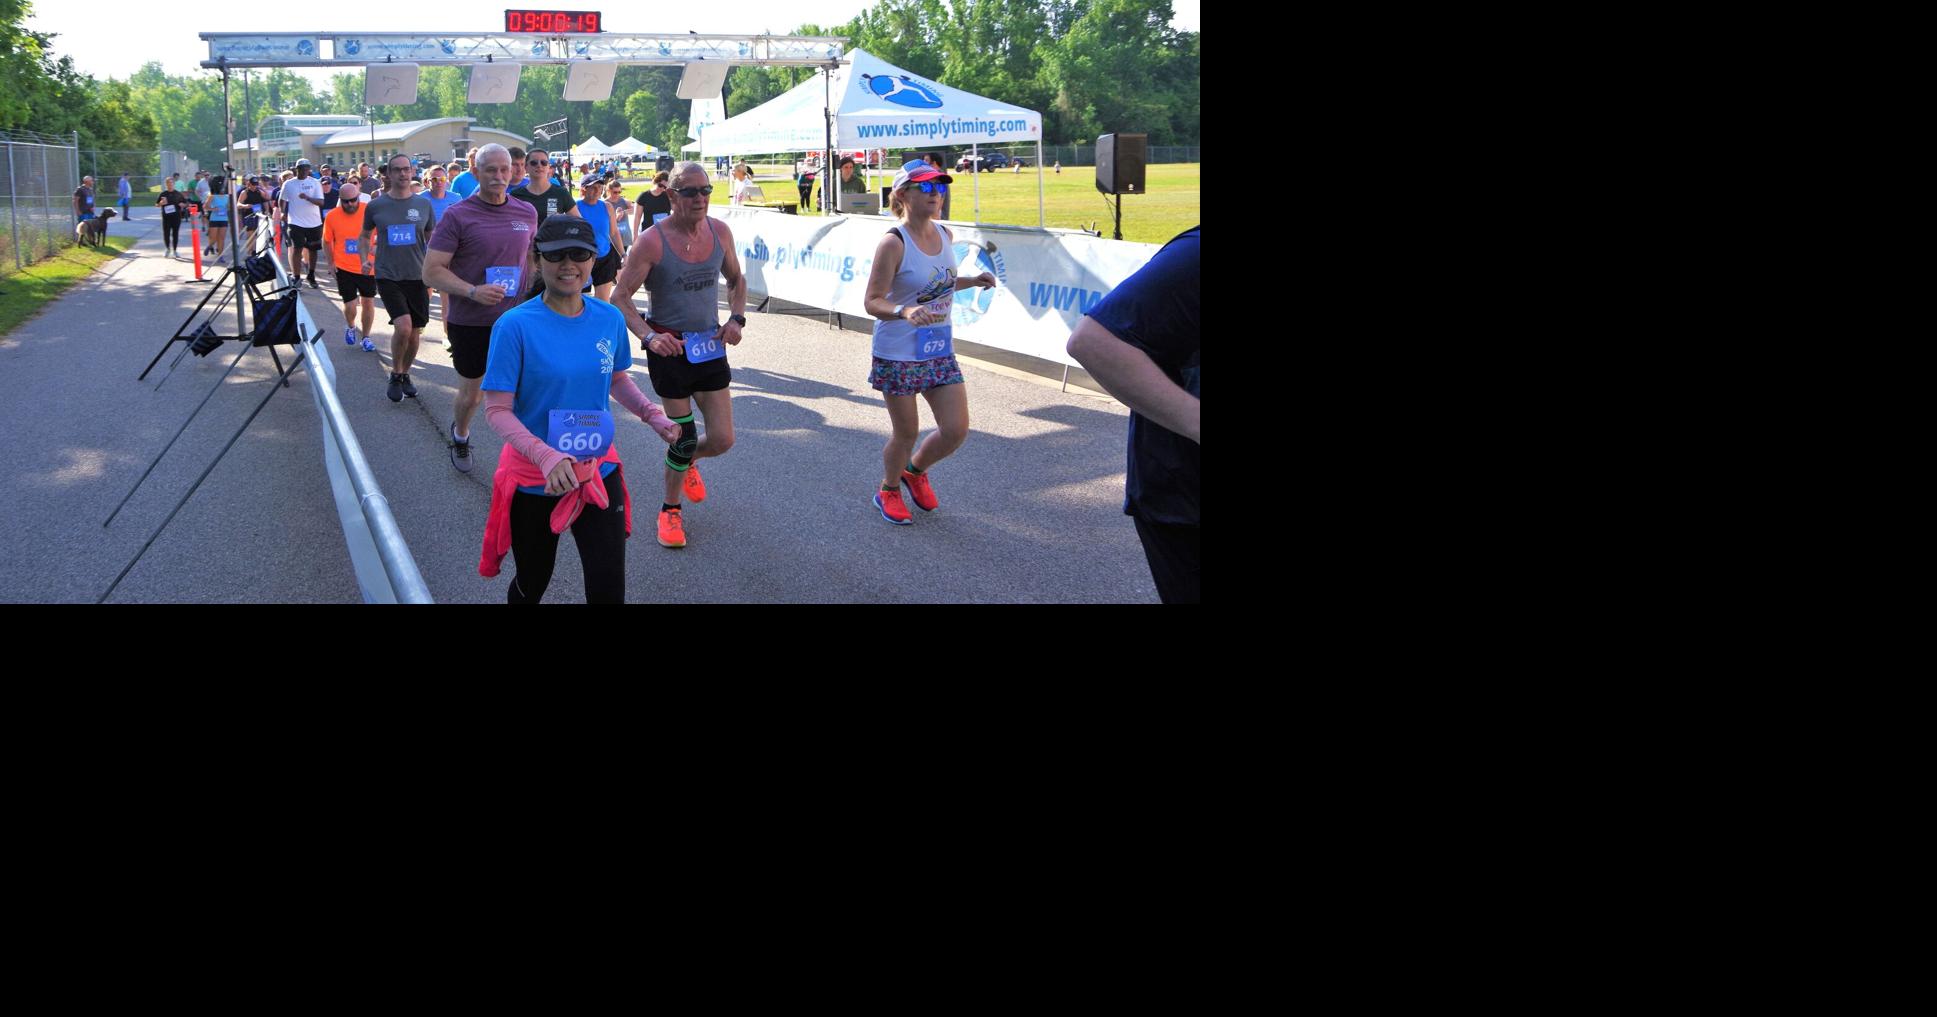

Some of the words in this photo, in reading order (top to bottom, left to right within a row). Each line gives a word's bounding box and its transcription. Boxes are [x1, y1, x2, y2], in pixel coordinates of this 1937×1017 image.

[509, 12, 597, 32] 09:00:19
[857, 117, 1026, 139] www.simplytiming.com
[392, 232, 412, 242] 714
[347, 244, 358, 252] 61
[692, 339, 717, 356] 610
[923, 340, 945, 353] 679
[558, 432, 603, 451] 660
